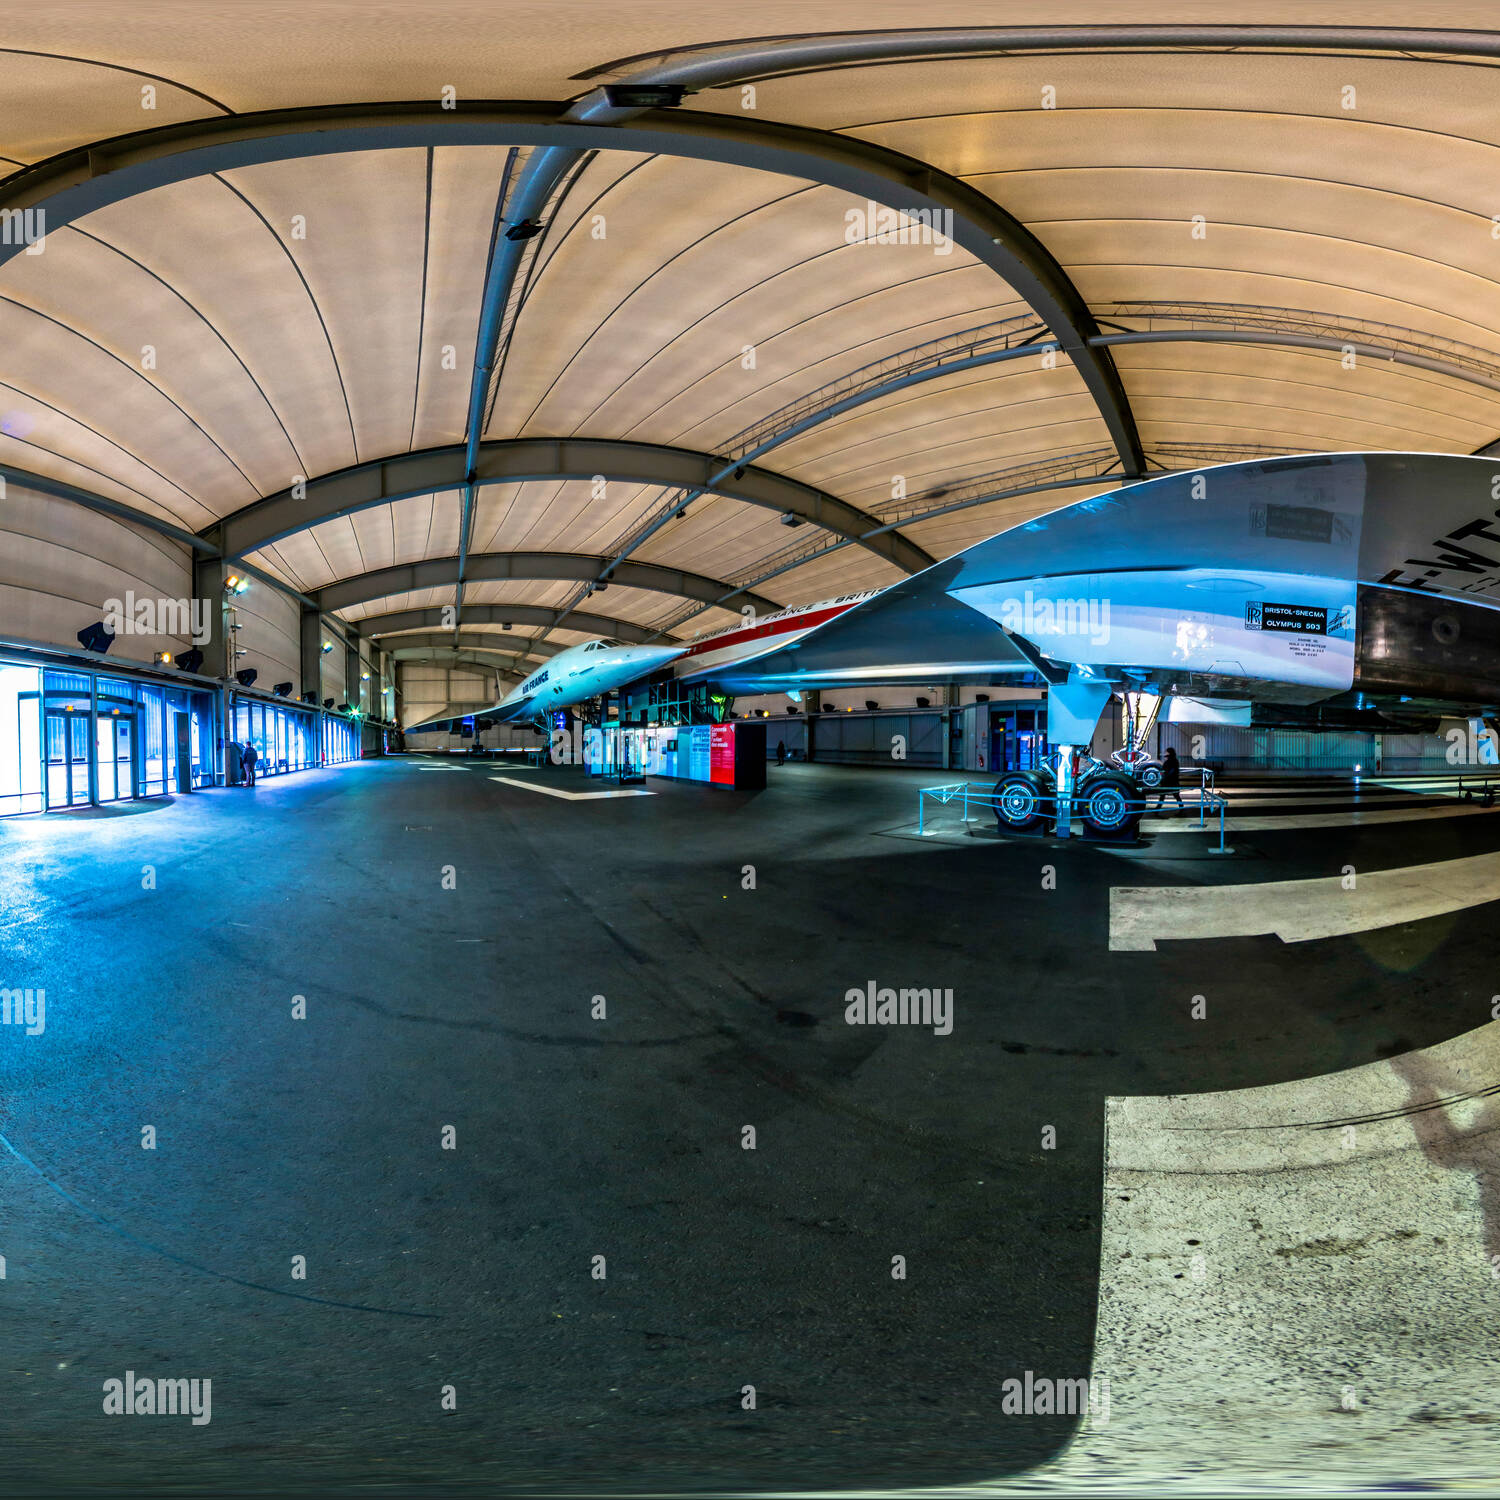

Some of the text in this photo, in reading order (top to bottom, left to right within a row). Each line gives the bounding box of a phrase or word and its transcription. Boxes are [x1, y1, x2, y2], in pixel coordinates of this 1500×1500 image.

[763, 603, 815, 621] FRANCE
[1265, 607, 1325, 618] BRISTOL-SNECMA
[1266, 620, 1302, 629] OLYMPUS
[530, 670, 549, 691] FRANCE
